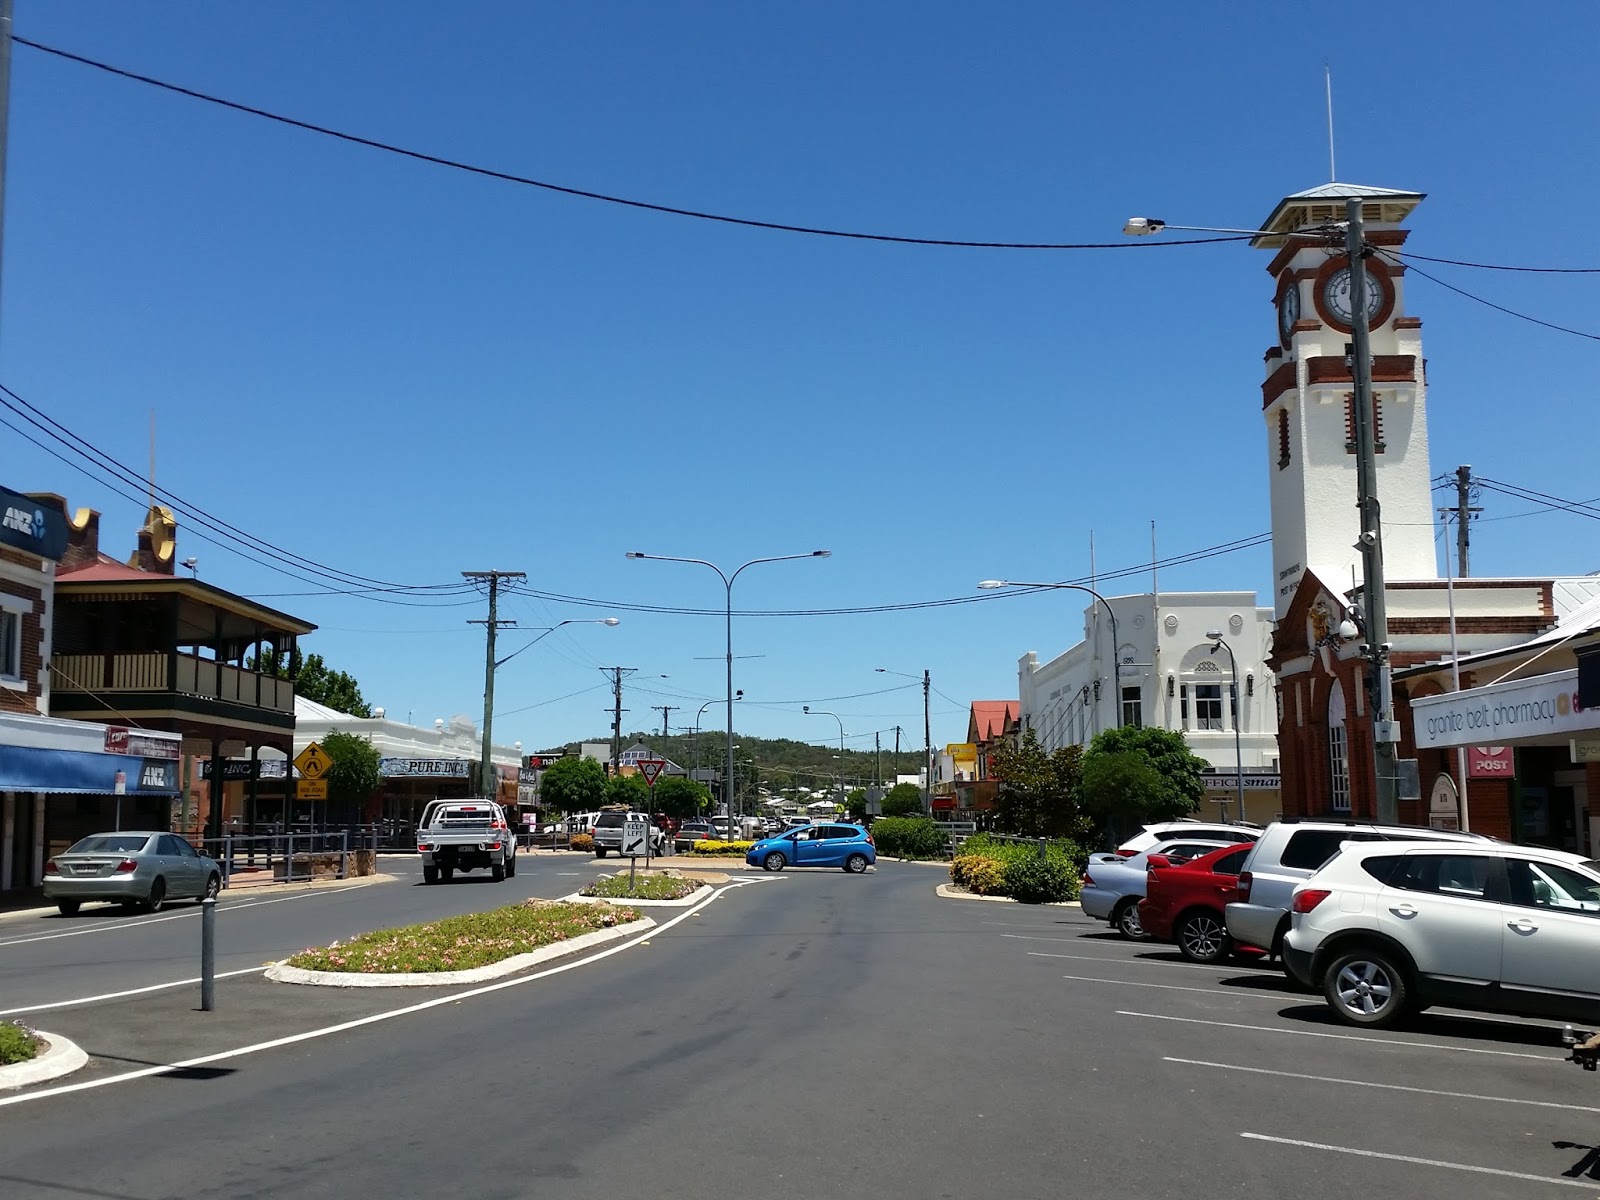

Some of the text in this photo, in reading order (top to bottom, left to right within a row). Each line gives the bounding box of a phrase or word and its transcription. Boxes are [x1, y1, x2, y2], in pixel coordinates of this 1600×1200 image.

[2, 506, 32, 535] ANZ
[1427, 698, 1556, 740] granite belt pharmacy
[1580, 746, 1600, 757] gra
[408, 761, 464, 774] PURE INCA
[542, 757, 560, 766] nab
[1476, 760, 1509, 772] POST
[227, 763, 252, 775] INC
[142, 766, 165, 787] ANZ
[1243, 778, 1281, 787] smar
